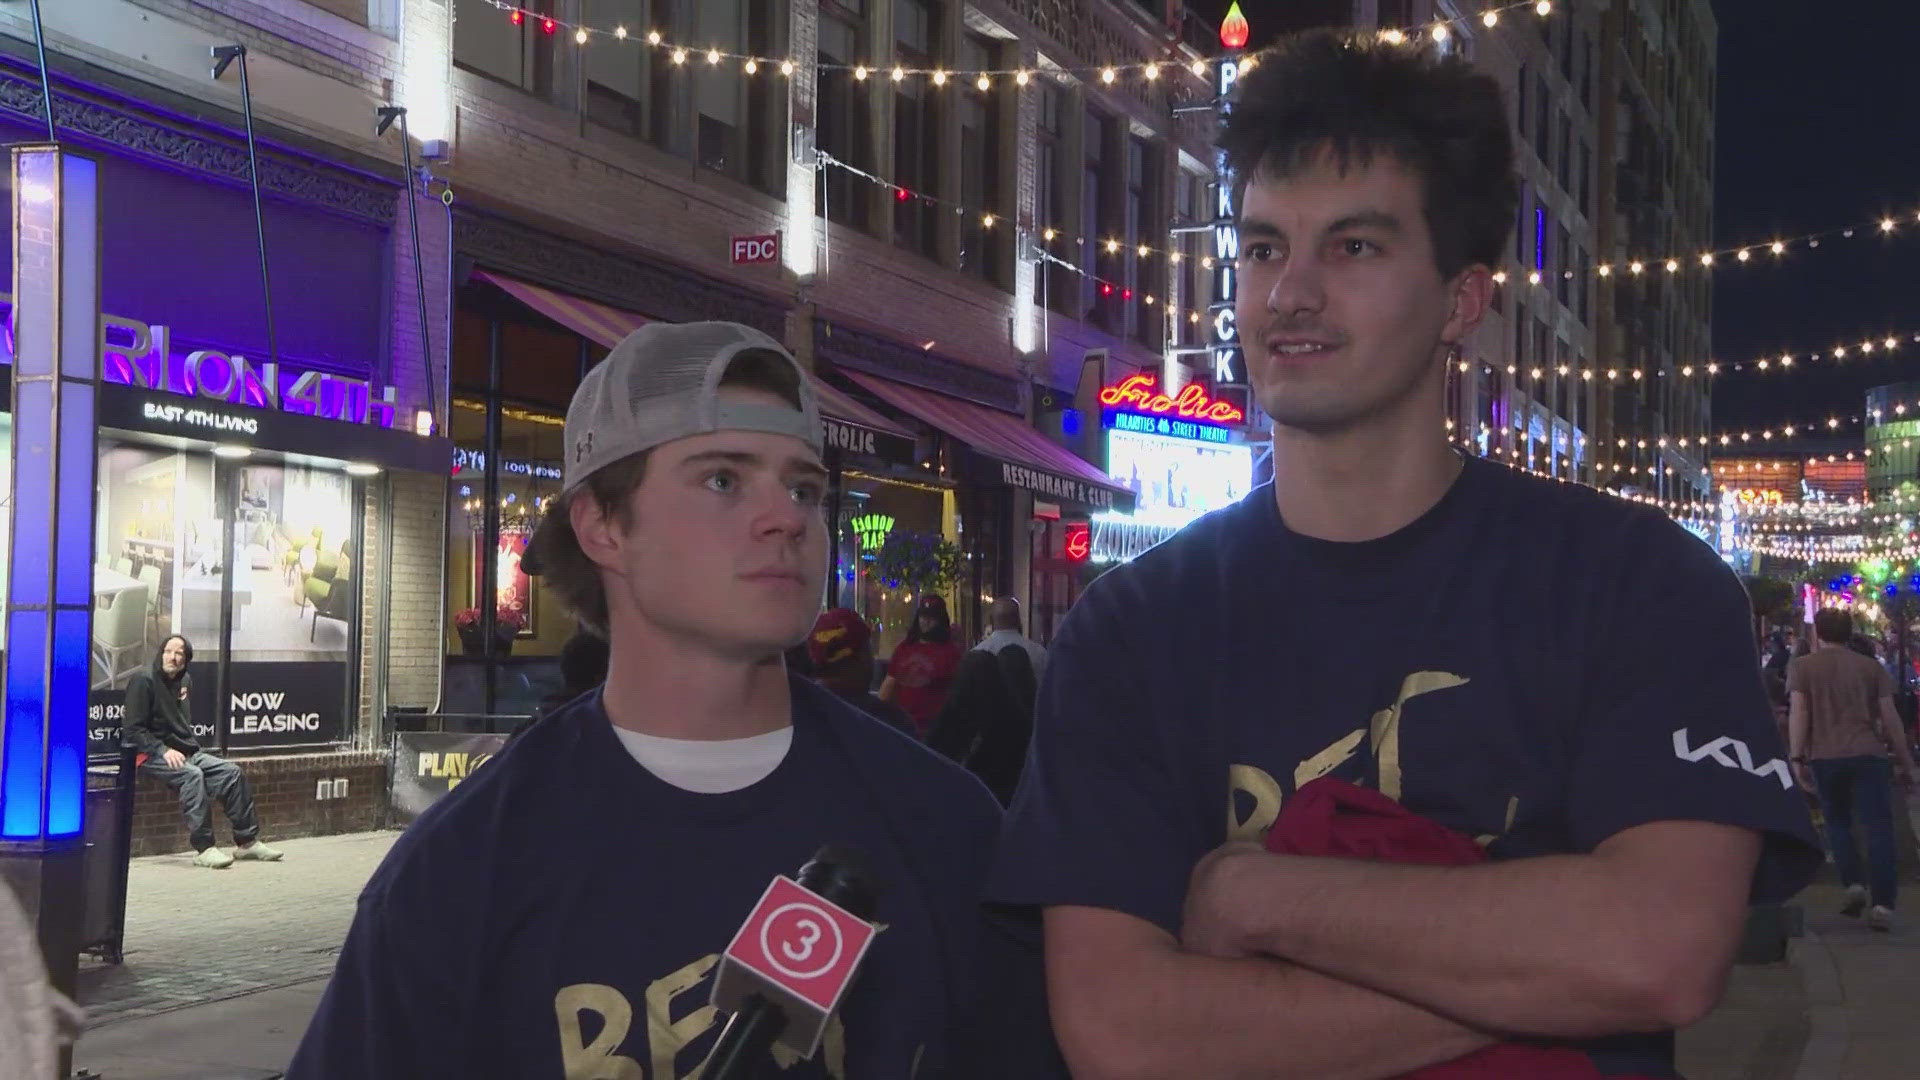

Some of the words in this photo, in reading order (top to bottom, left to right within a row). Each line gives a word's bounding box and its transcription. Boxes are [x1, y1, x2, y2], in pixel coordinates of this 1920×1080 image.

[1217, 62, 1238, 383] PKWICK
[734, 239, 775, 260] FDC
[100, 312, 170, 392] RI
[184, 350, 279, 410] ON
[284, 371, 399, 429] 4TH
[1101, 376, 1241, 421] Frolic
[144, 402, 184, 422] EAST
[185, 408, 214, 428] 4TH
[215, 413, 258, 434] LIVING
[1116, 412, 1155, 433] HILARITIES
[1172, 420, 1197, 438] STREET
[1199, 425, 1229, 442] THEATRE
[1002, 462, 1075, 500] RESTAURANT
[1088, 486, 1114, 508] CLUB
[230, 692, 285, 711] NOW
[230, 712, 320, 735] LEASING
[418, 752, 469, 778] PLAY
[782, 919, 822, 962] 3
